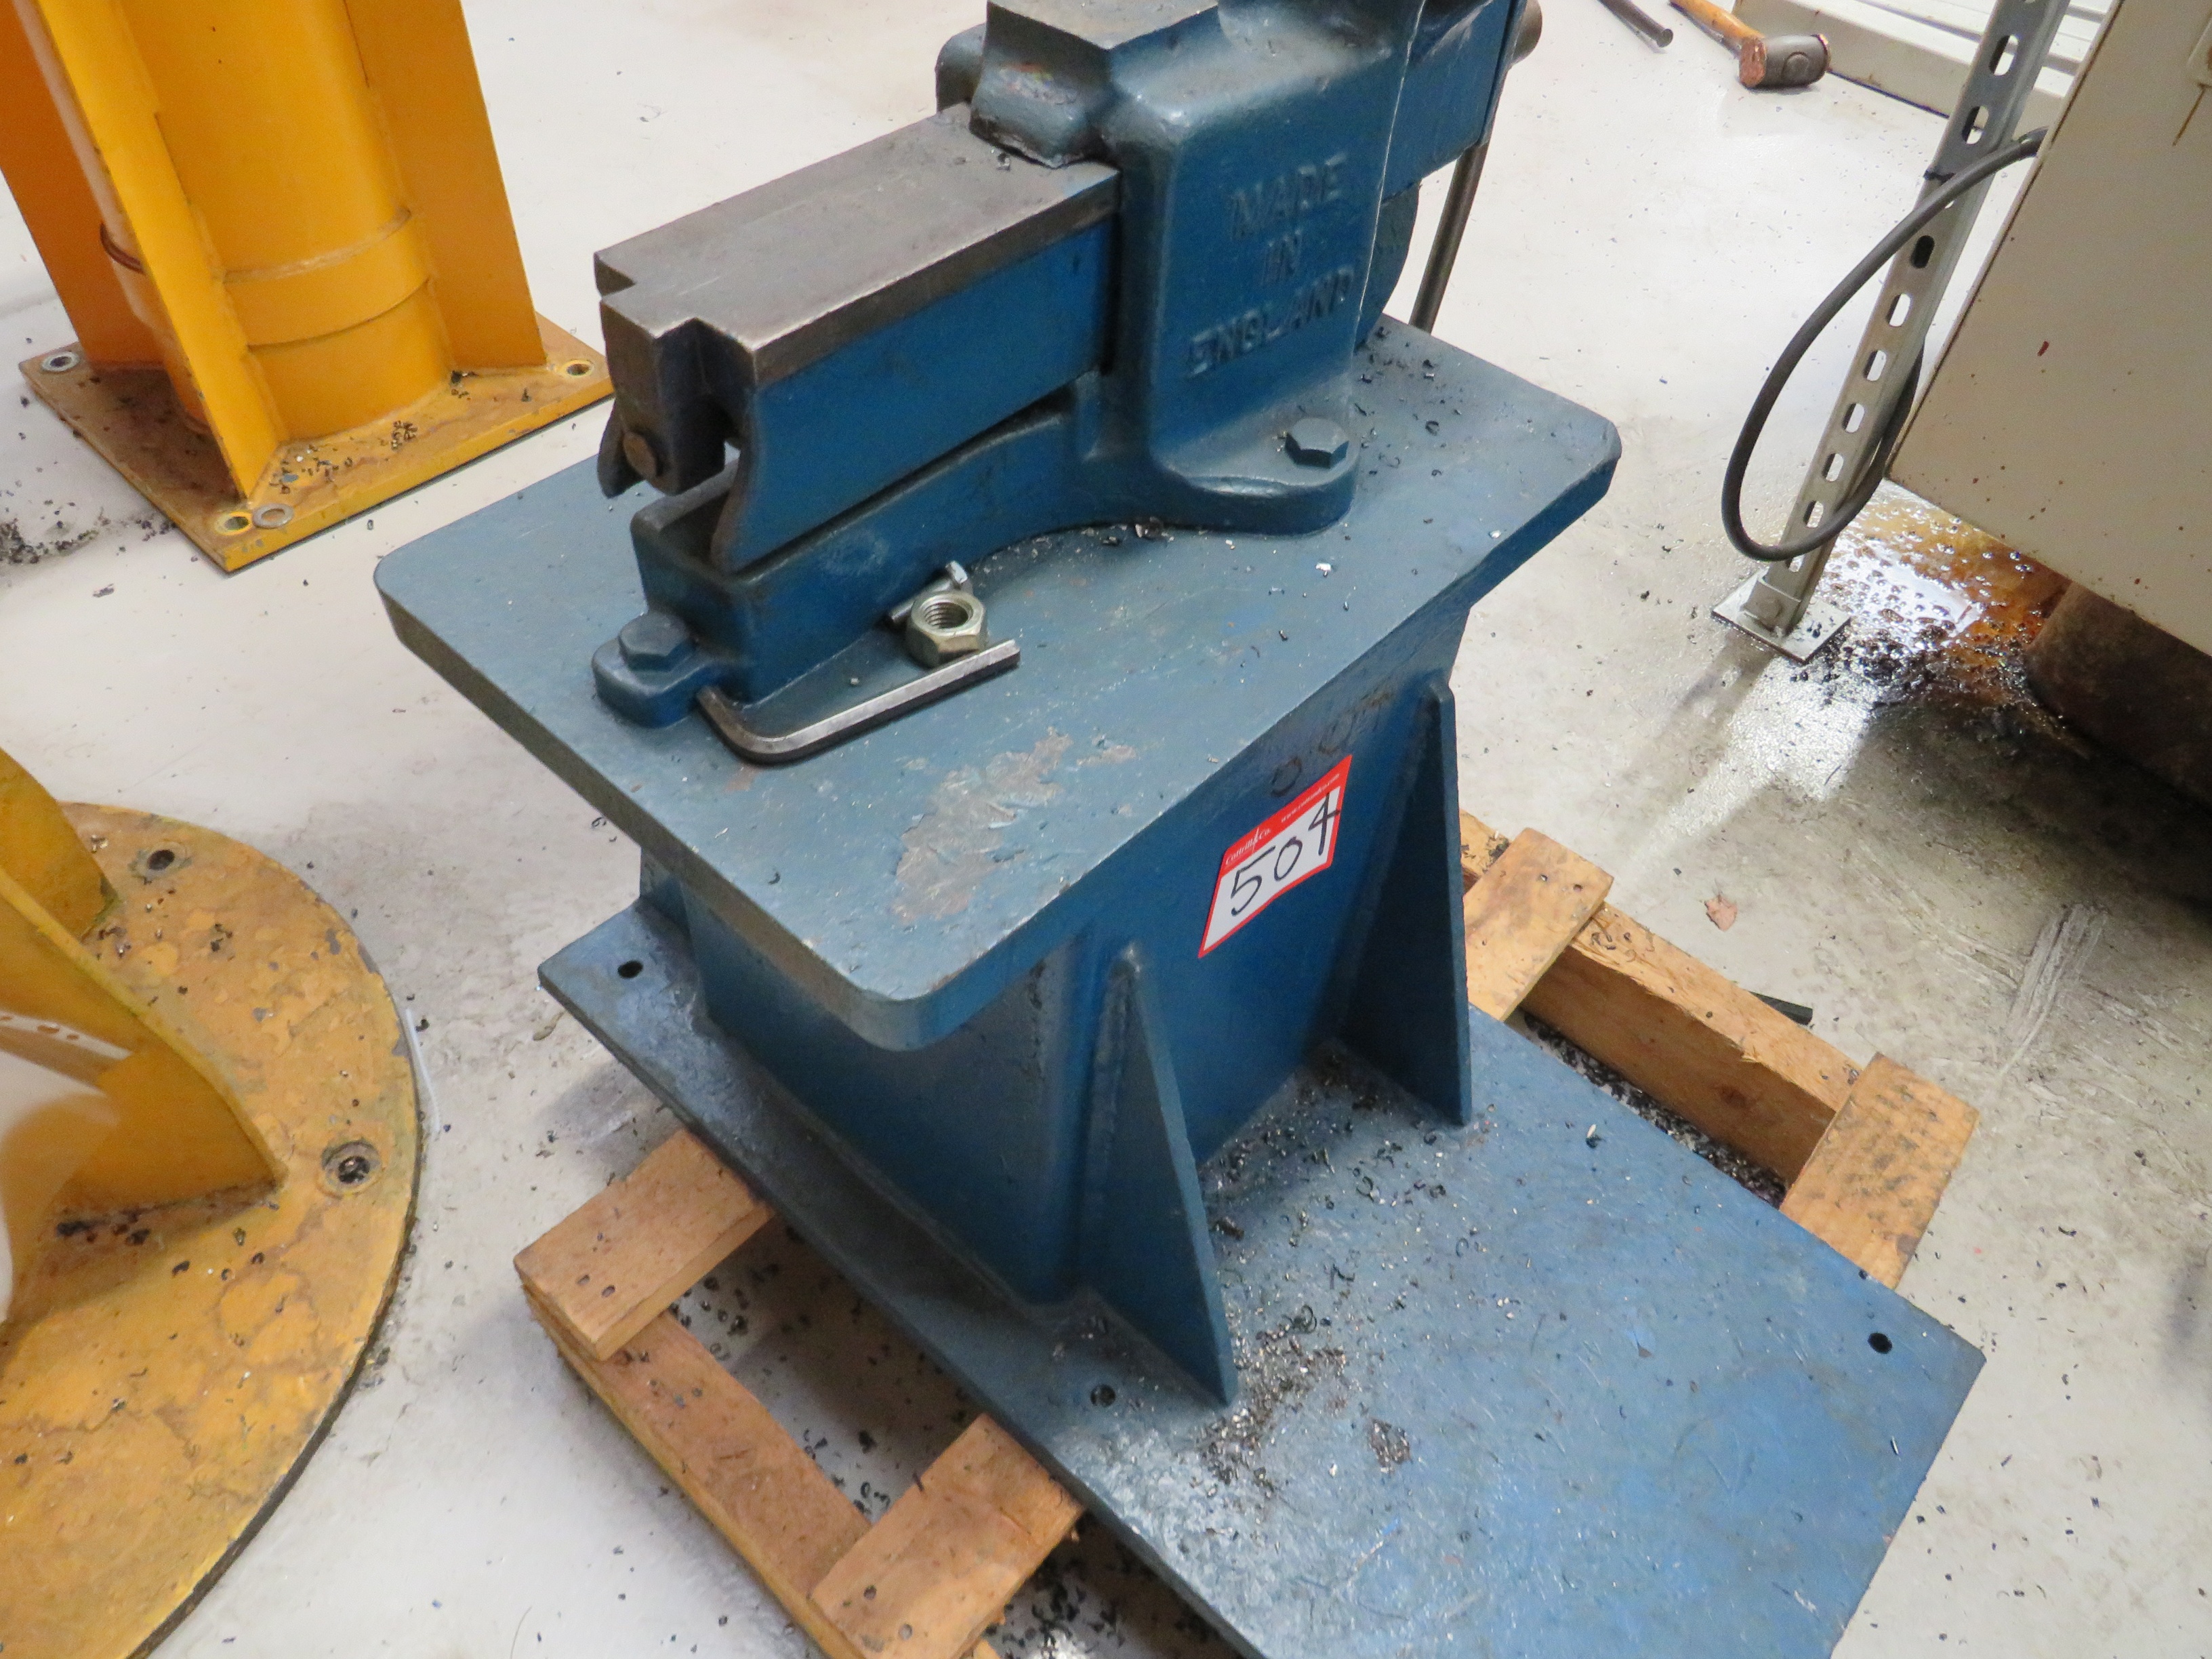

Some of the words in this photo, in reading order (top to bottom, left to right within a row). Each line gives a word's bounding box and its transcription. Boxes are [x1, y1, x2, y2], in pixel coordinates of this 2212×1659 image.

[1227, 154, 1347, 242] MADE
[1261, 229, 1306, 289] IN
[1185, 267, 1355, 379] ENGLAND
[1231, 792, 1342, 916] 504
